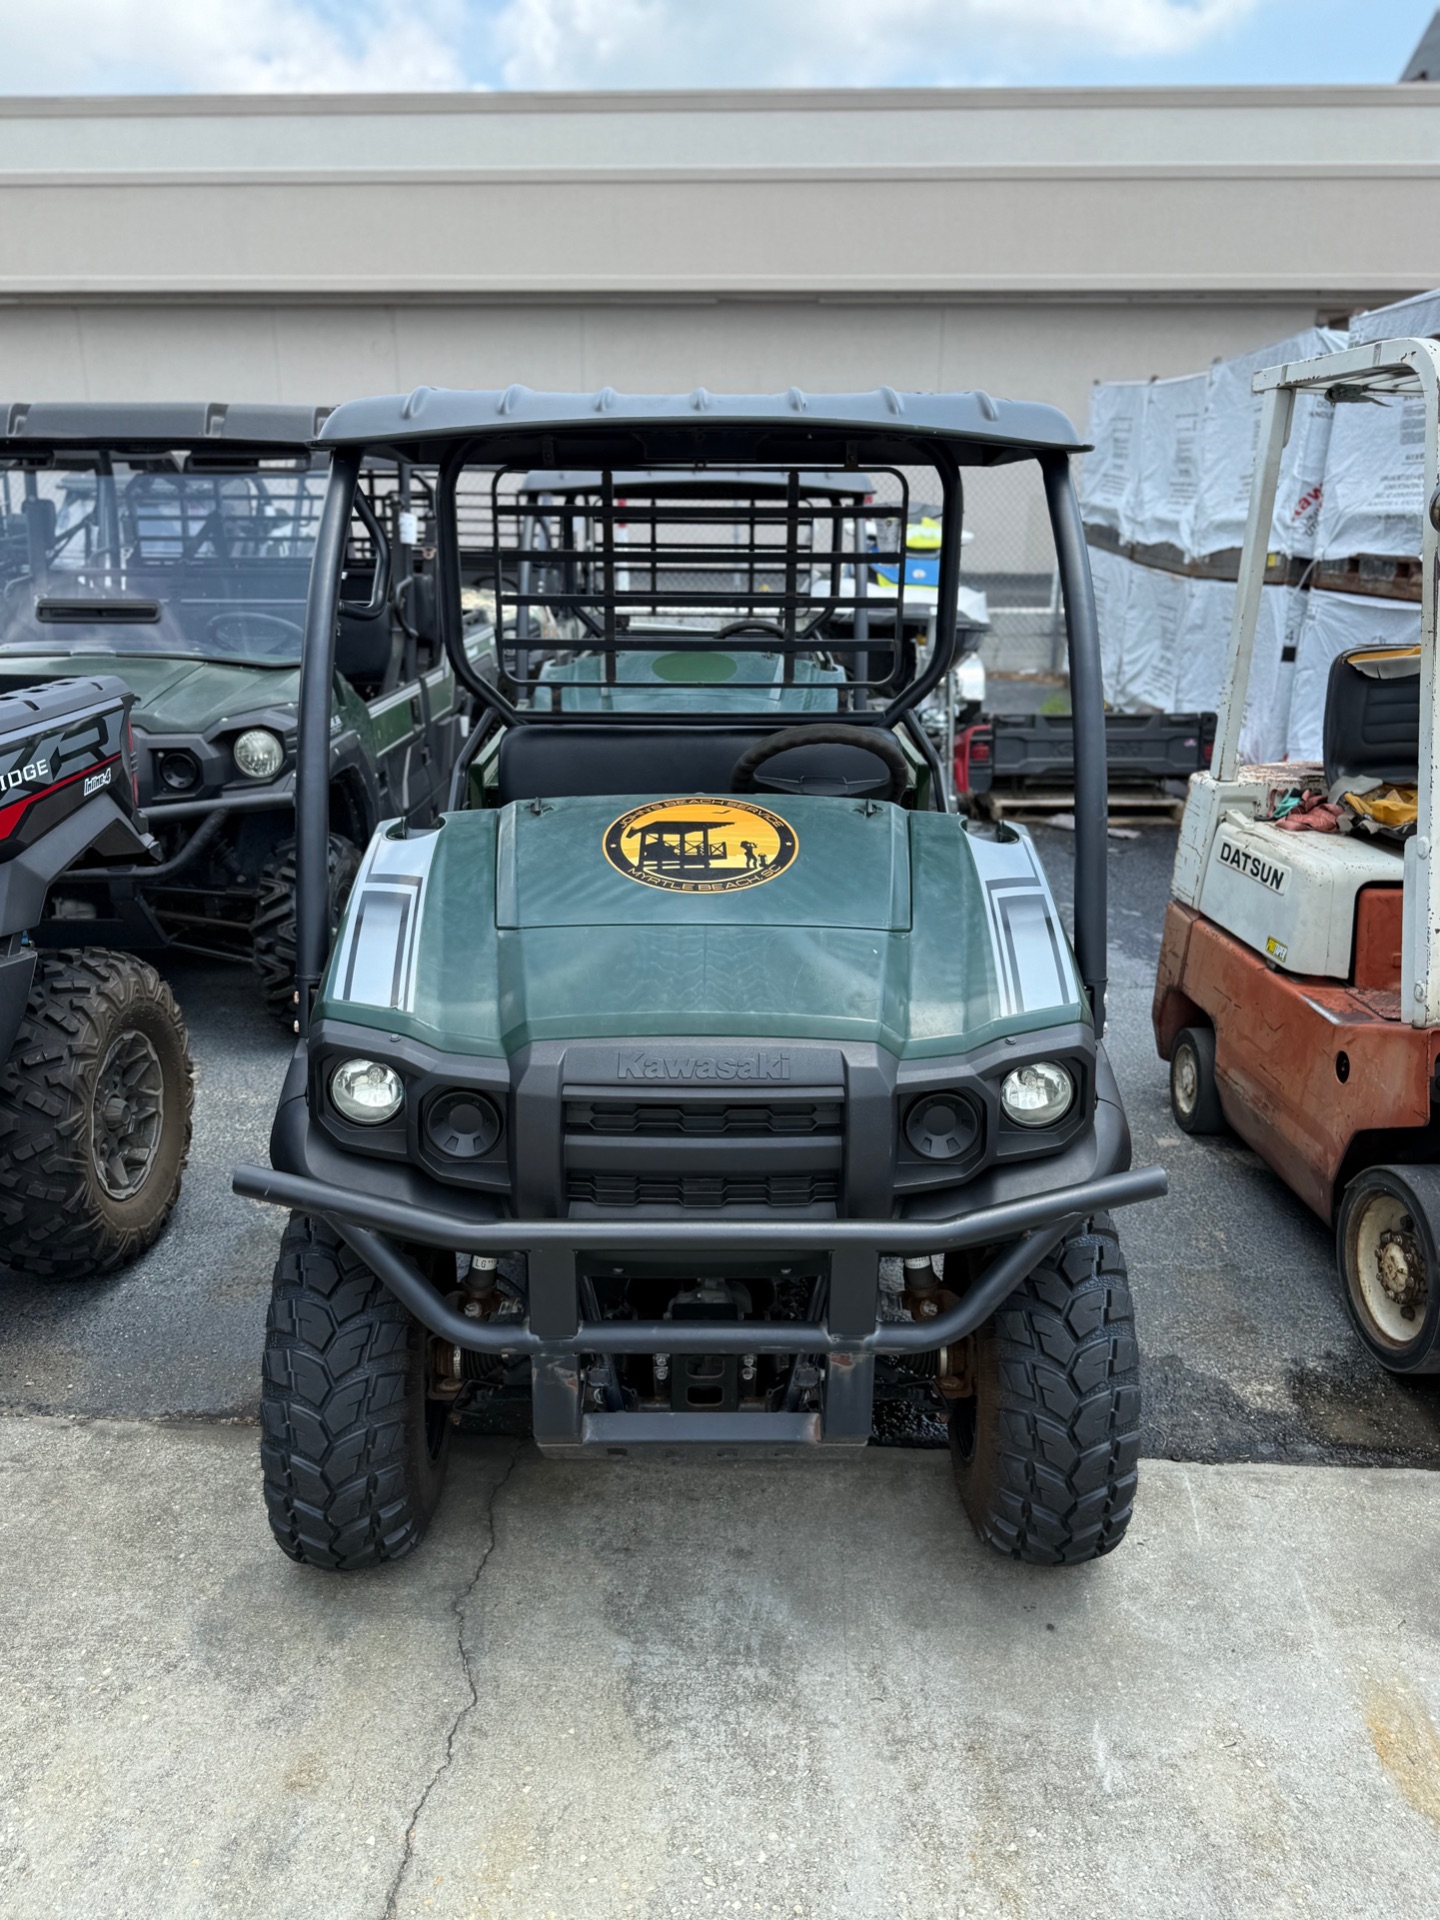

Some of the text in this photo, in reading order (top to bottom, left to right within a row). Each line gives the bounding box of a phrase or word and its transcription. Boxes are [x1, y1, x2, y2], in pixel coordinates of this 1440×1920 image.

[619, 799, 784, 829] JOHN'S BEACH SERVICE
[628, 867, 694, 891] MYRTLE
[763, 864, 782, 879] SC
[1220, 842, 1284, 890] DATSUN
[617, 1052, 791, 1081] Kawasaki
